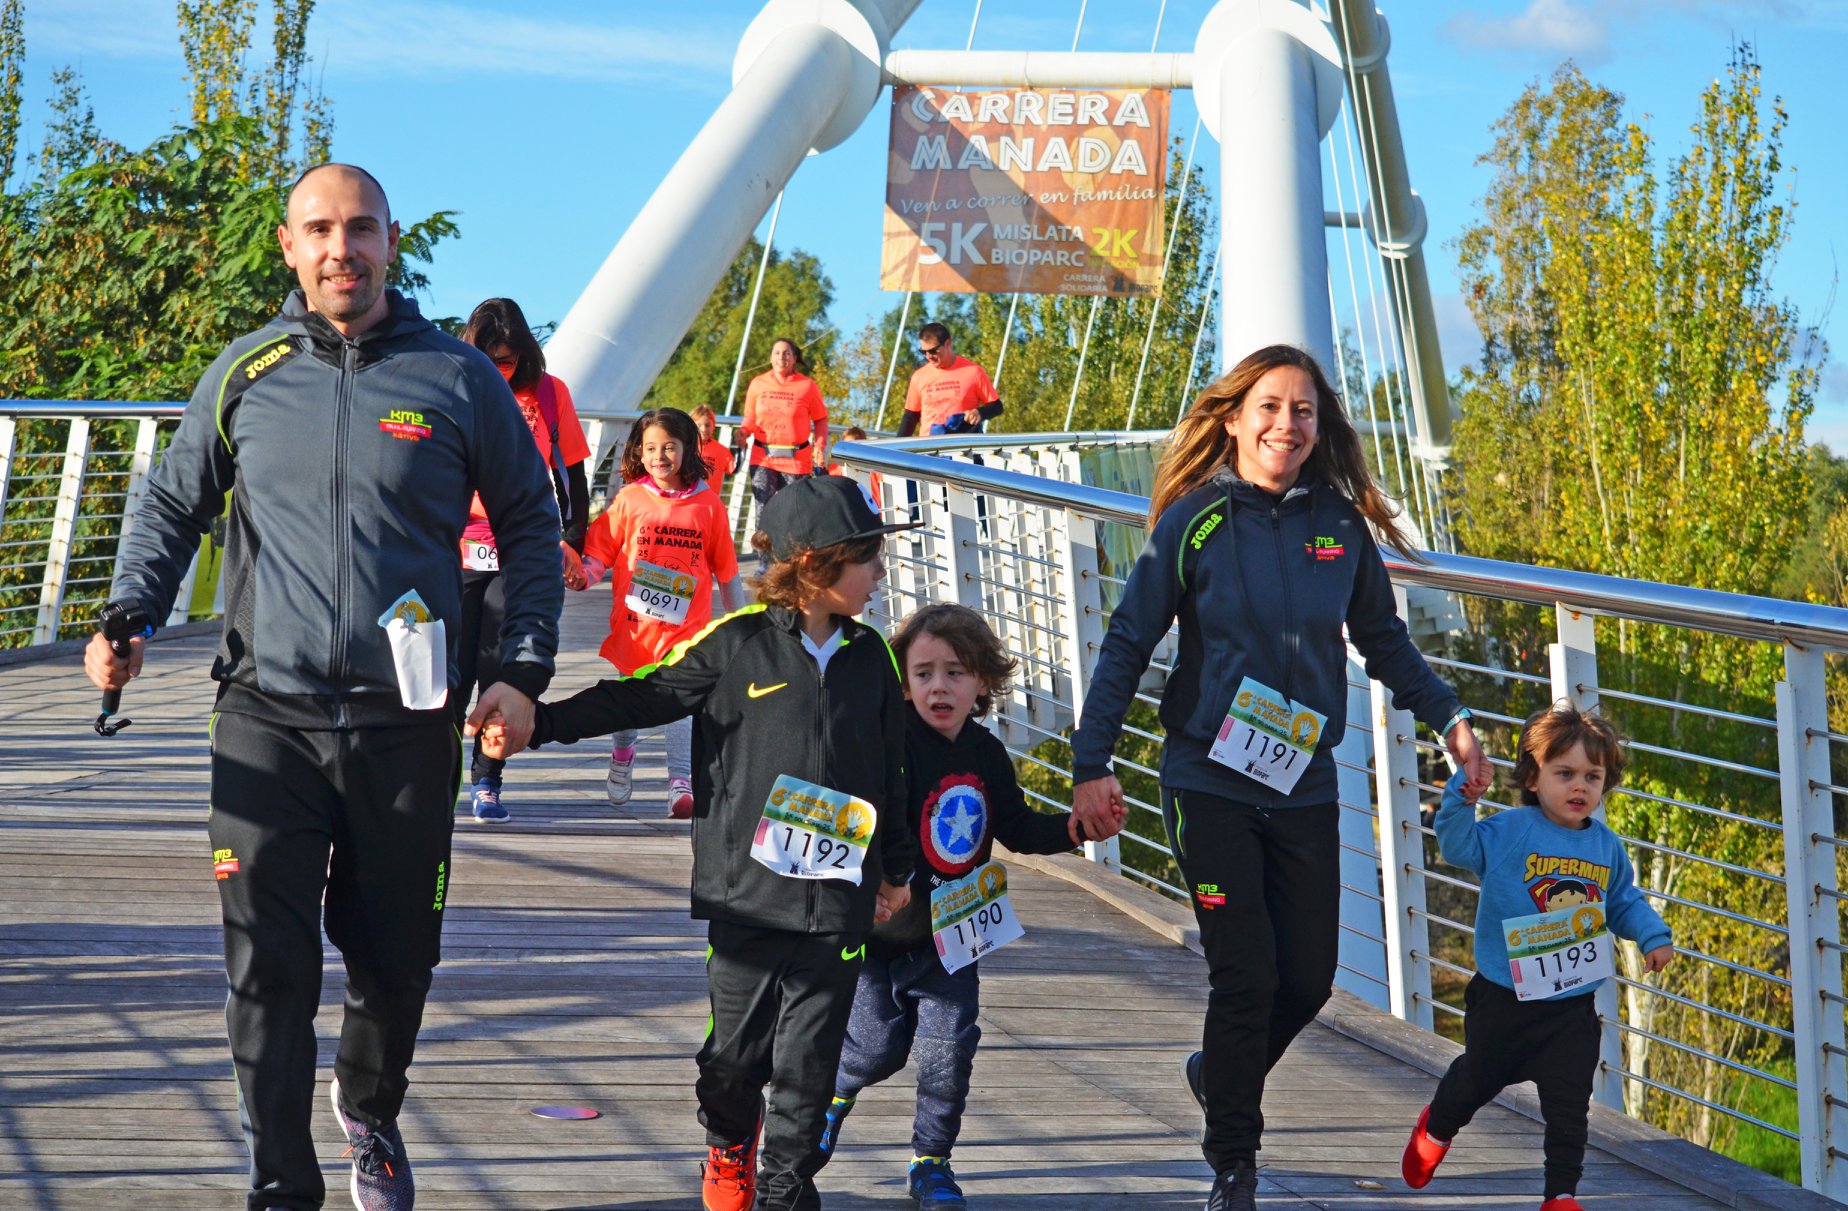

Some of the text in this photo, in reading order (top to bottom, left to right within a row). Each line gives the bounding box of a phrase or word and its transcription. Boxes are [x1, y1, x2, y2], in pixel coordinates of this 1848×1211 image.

[911, 90, 1150, 128] CARRERA
[910, 134, 1148, 175] MANADA
[901, 184, 1157, 215] Ven a correr en familia
[918, 222, 991, 265] 5K
[993, 223, 1085, 242] MISLATA
[1091, 227, 1139, 258] 2K
[991, 248, 1085, 267] BIOPARC
[1063, 274, 1106, 282] CARRERA
[637, 537, 702, 550] EN MANADA
[654, 526, 702, 539] CARRERA
[478, 546, 498, 560] 06
[640, 588, 680, 611] 0691
[1244, 728, 1298, 770] 1191
[785, 827, 850, 869] 1192
[930, 874, 941, 887] THE
[1523, 852, 1611, 892] SUPERMAN
[954, 902, 1003, 945] 1190
[1525, 920, 1568, 934] CARRERA
[1527, 928, 1571, 944] MANADA
[1535, 941, 1597, 977] 1193
